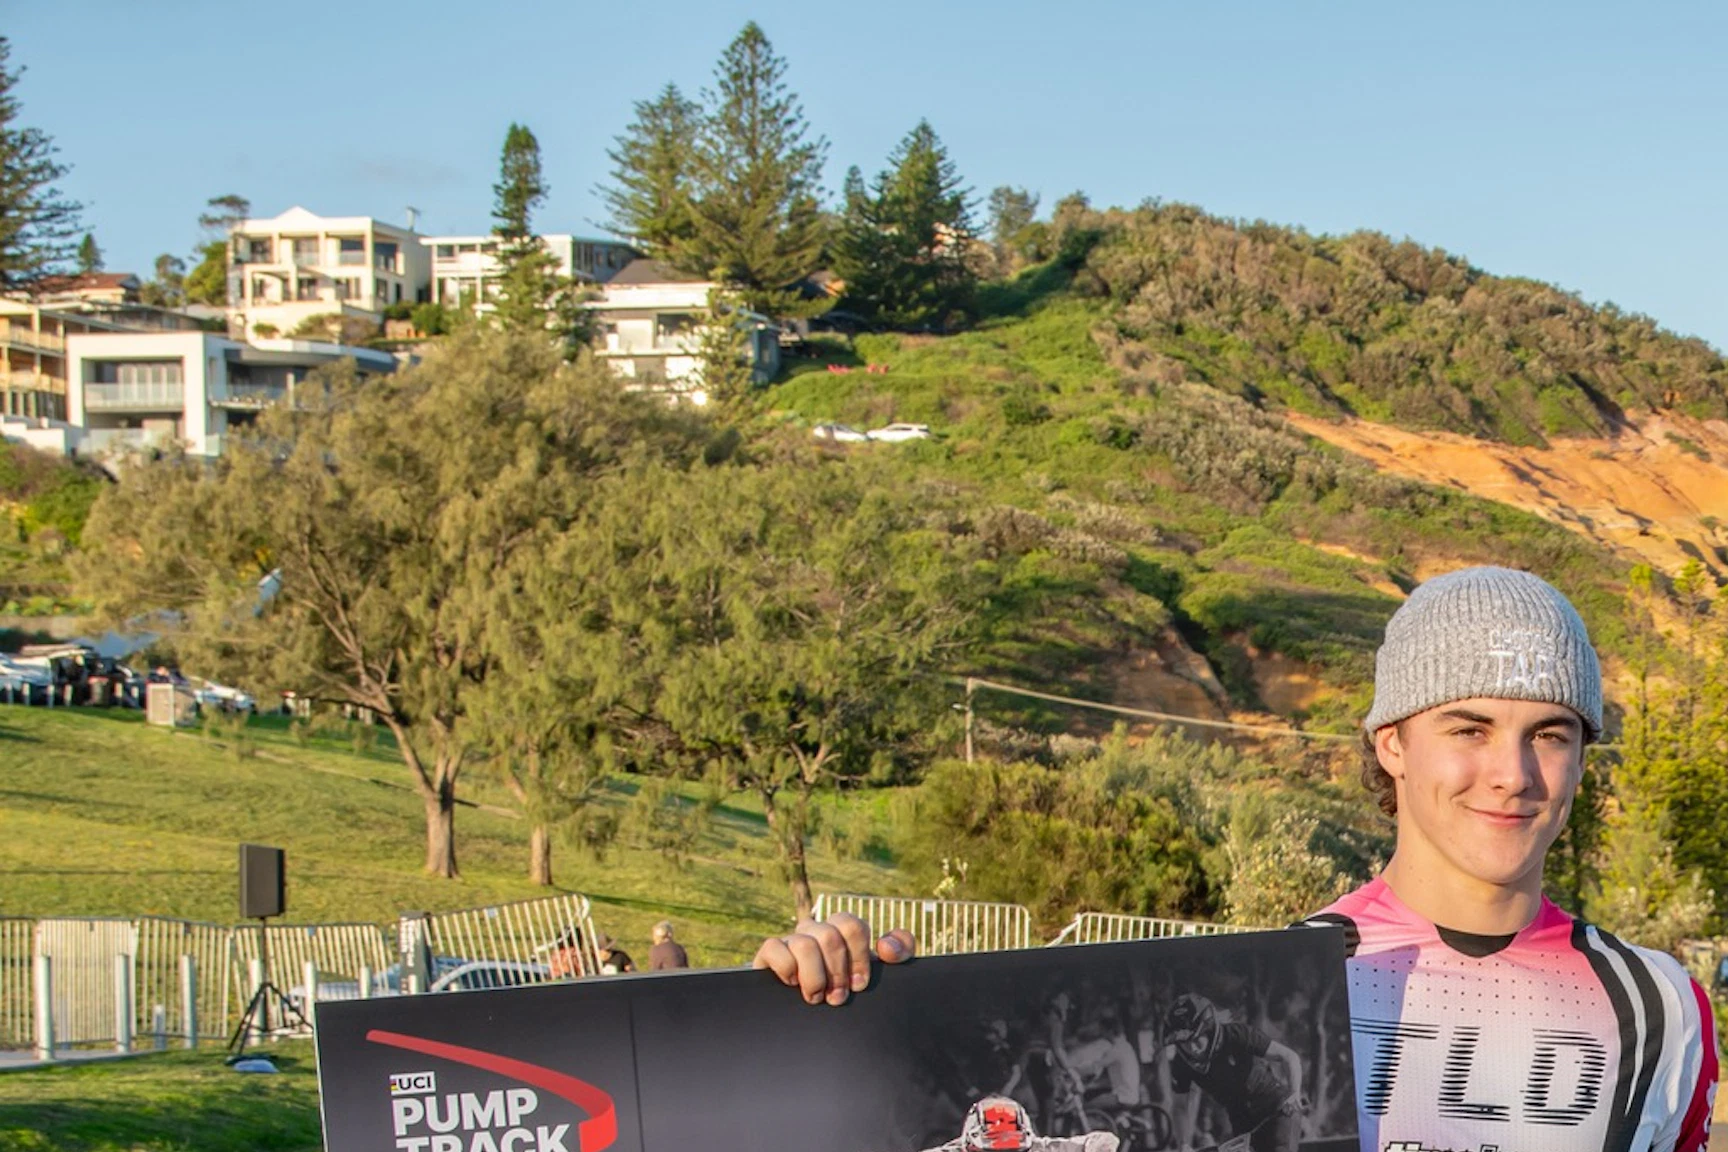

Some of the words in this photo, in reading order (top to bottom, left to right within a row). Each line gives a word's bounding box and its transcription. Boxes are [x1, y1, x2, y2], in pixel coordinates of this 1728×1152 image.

[399, 1076, 432, 1090] UCI
[1351, 1018, 1607, 1126] TLD
[392, 1087, 538, 1136] PUMP
